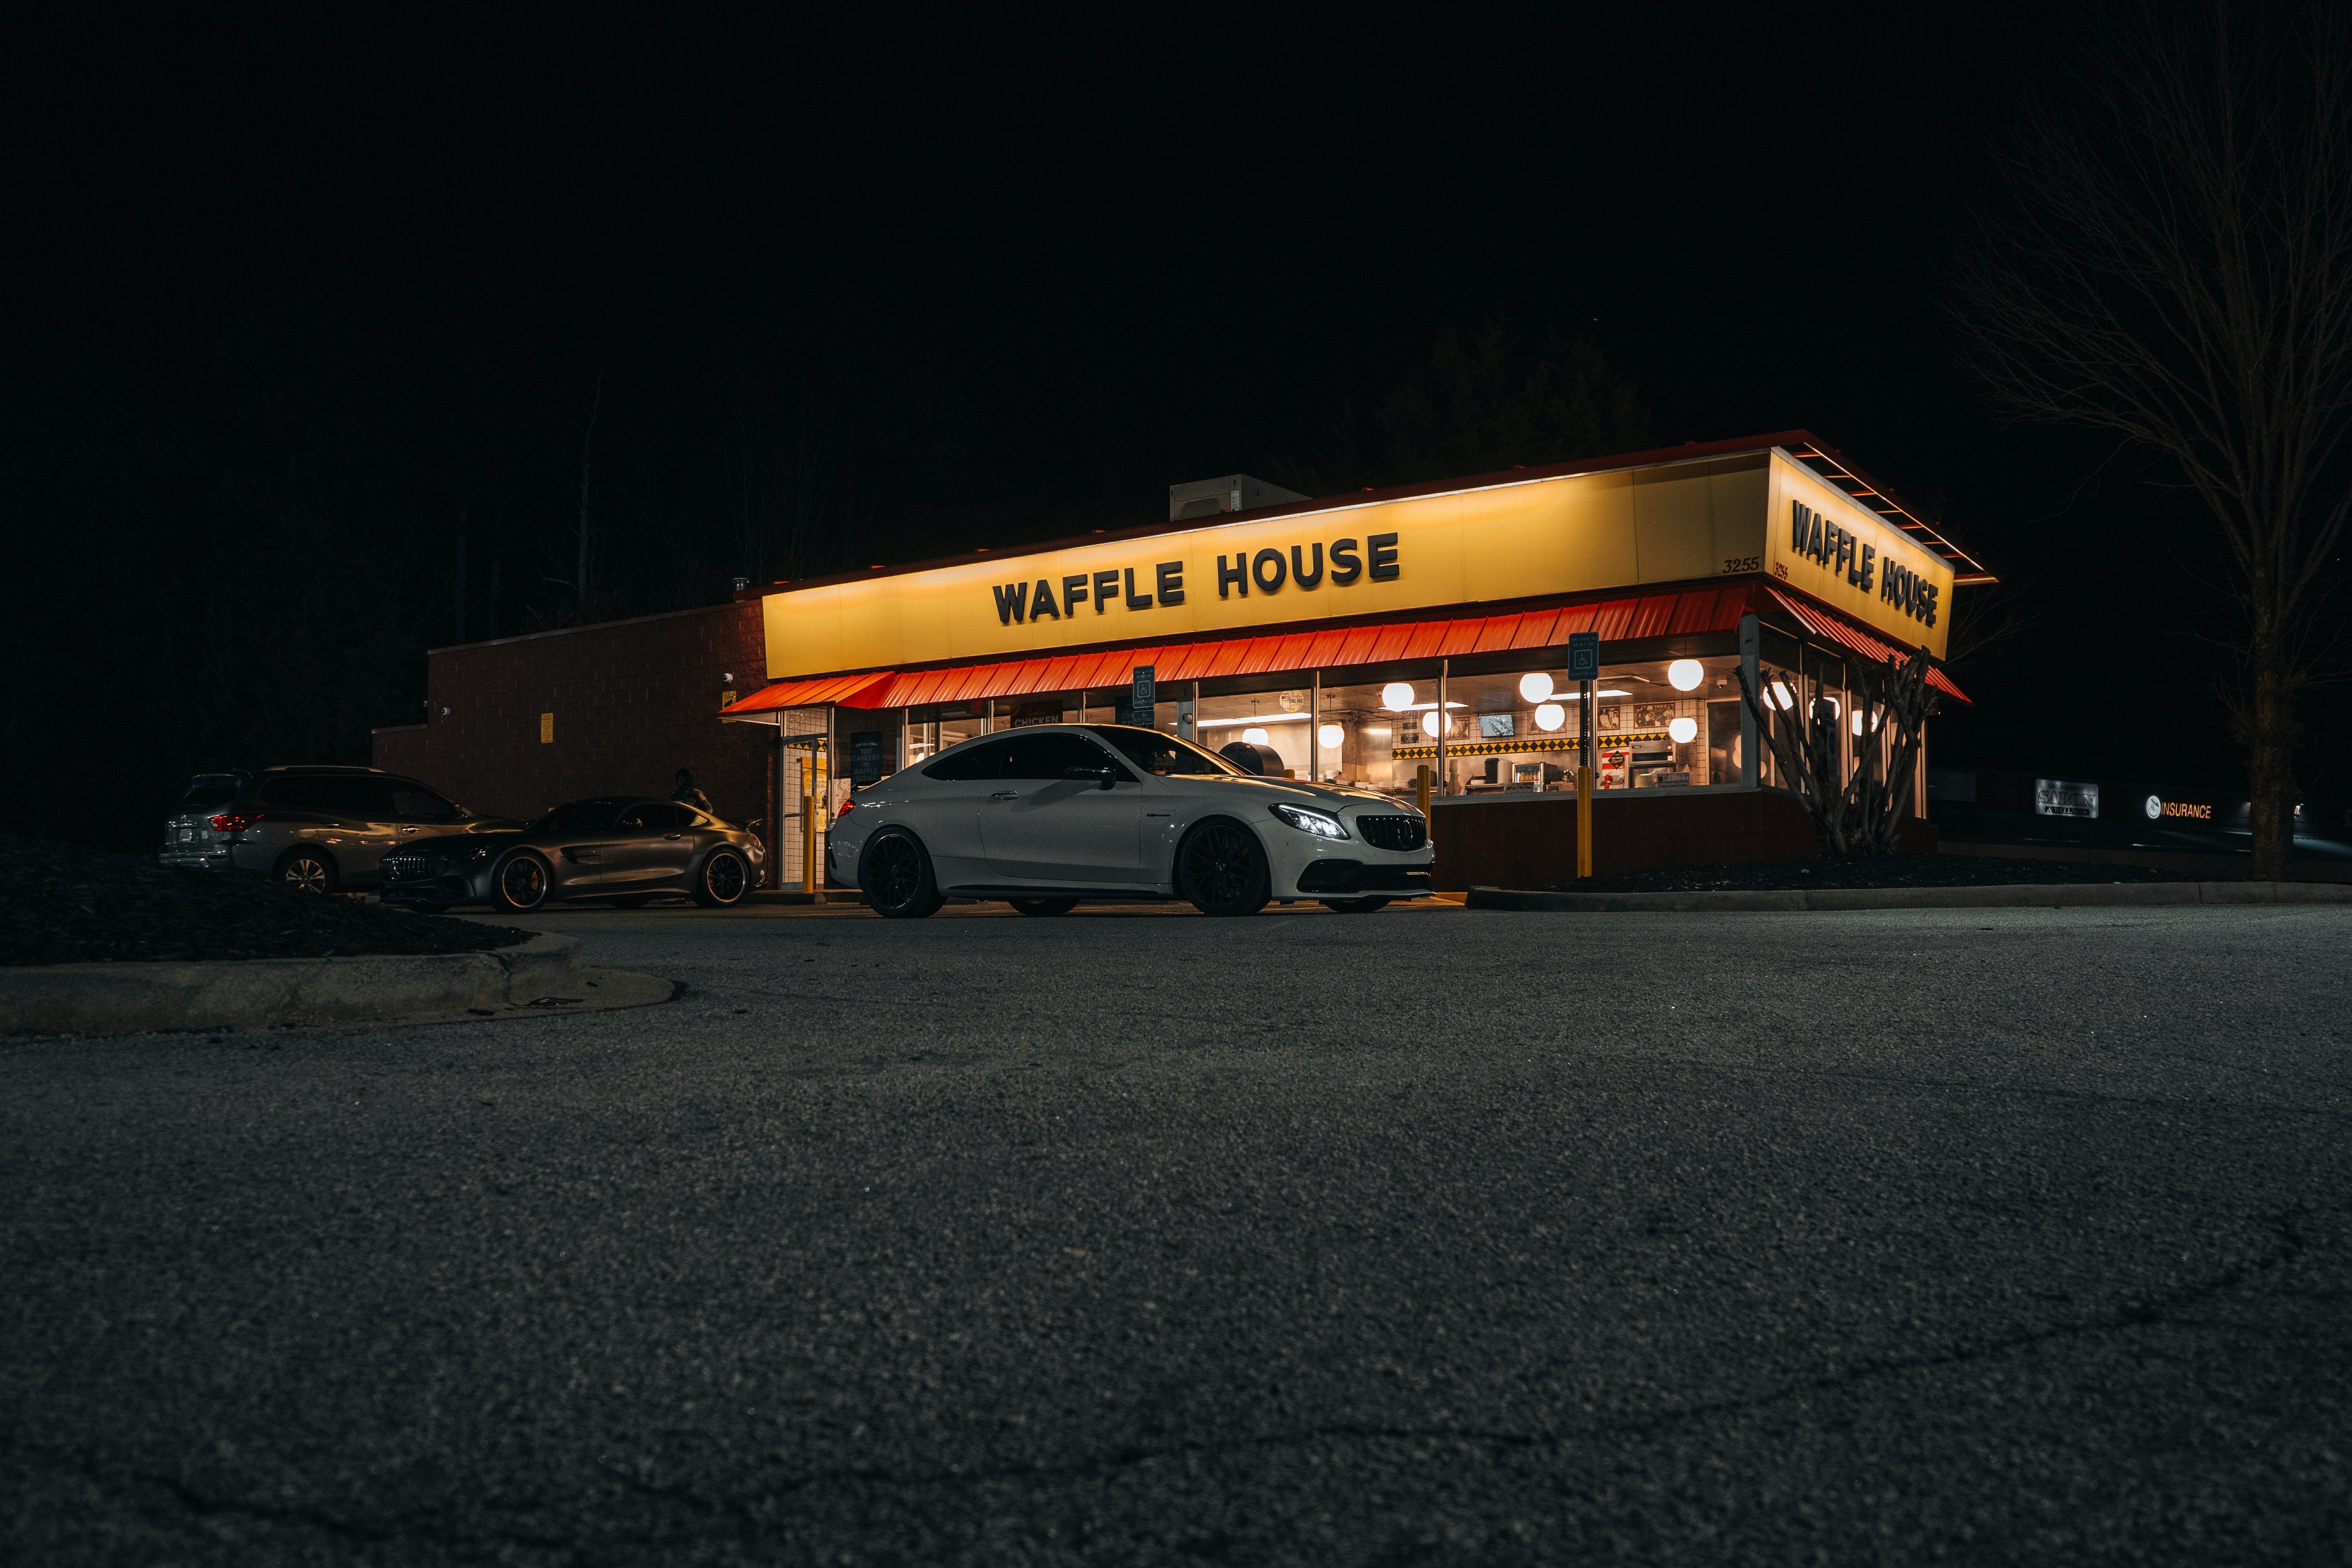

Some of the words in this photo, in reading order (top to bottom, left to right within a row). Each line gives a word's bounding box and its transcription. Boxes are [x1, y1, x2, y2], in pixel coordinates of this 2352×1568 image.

[1723, 556, 1759, 573] 3255
[1793, 500, 1875, 588] WAFFLE
[1881, 557, 1938, 625] HOUSE
[992, 561, 1185, 622] WAFFLE
[1217, 532, 1400, 596] HOUSE
[1014, 715, 1058, 727] CHICKEN
[2038, 790, 2096, 807] SALON
[2161, 802, 2212, 819] INSURANCE
